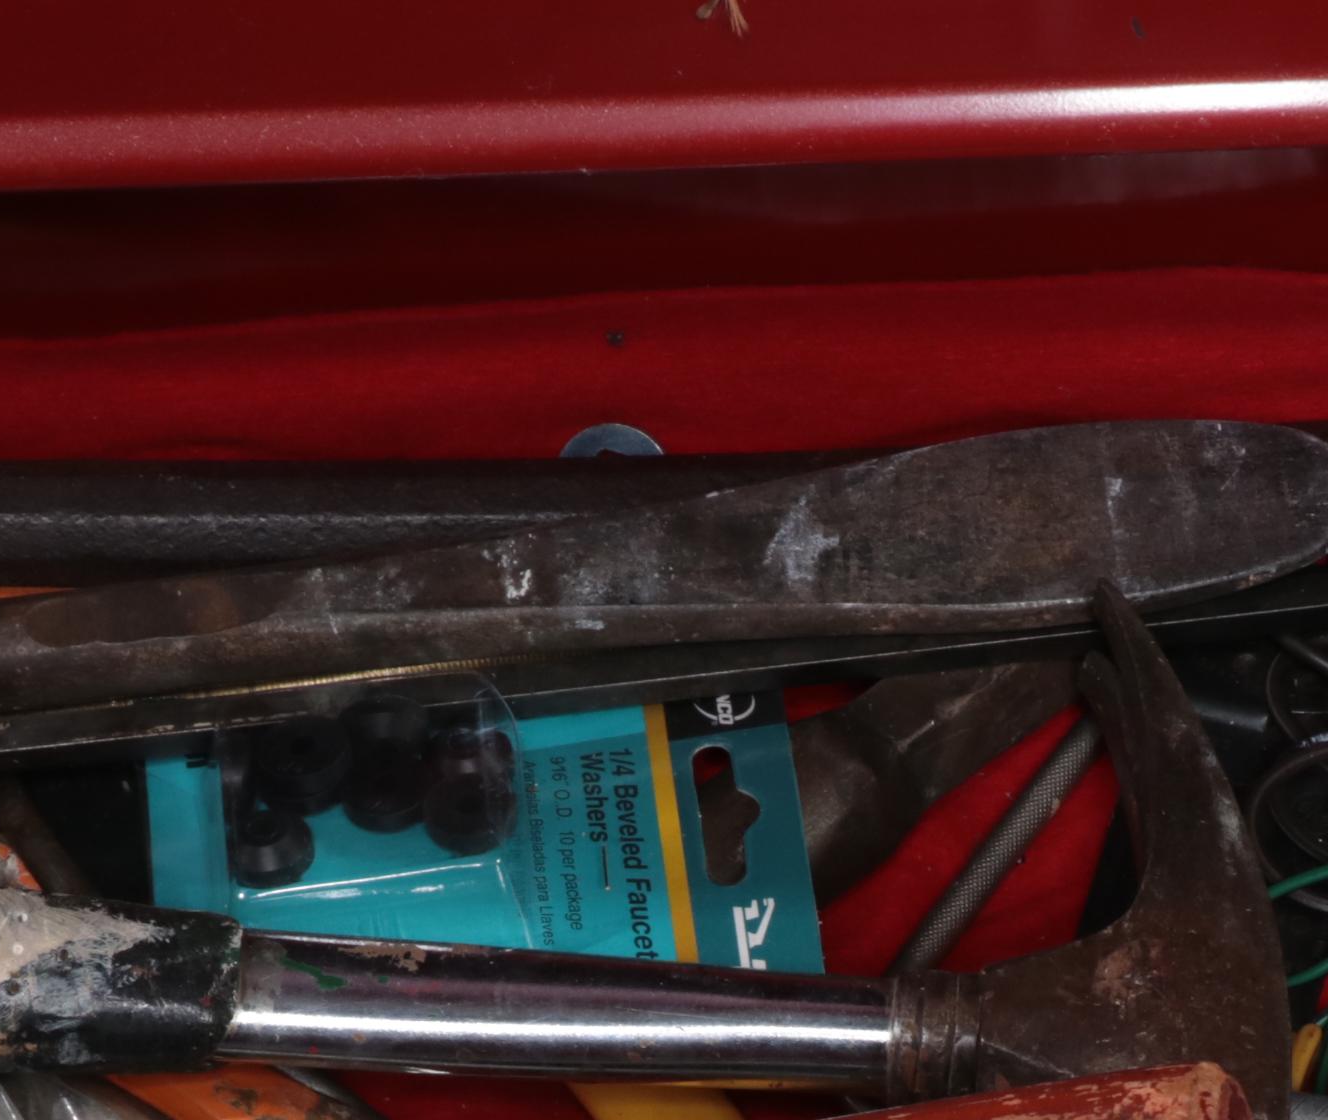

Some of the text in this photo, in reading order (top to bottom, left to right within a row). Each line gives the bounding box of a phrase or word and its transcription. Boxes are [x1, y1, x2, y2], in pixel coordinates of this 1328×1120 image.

[579, 752, 609, 842] Washers
[557, 849, 576, 870] per
[609, 748, 658, 959] 1/4 Beveled Faucet
[534, 875, 551, 902] para
[559, 872, 583, 931] package
[539, 906, 555, 946] Llaves
